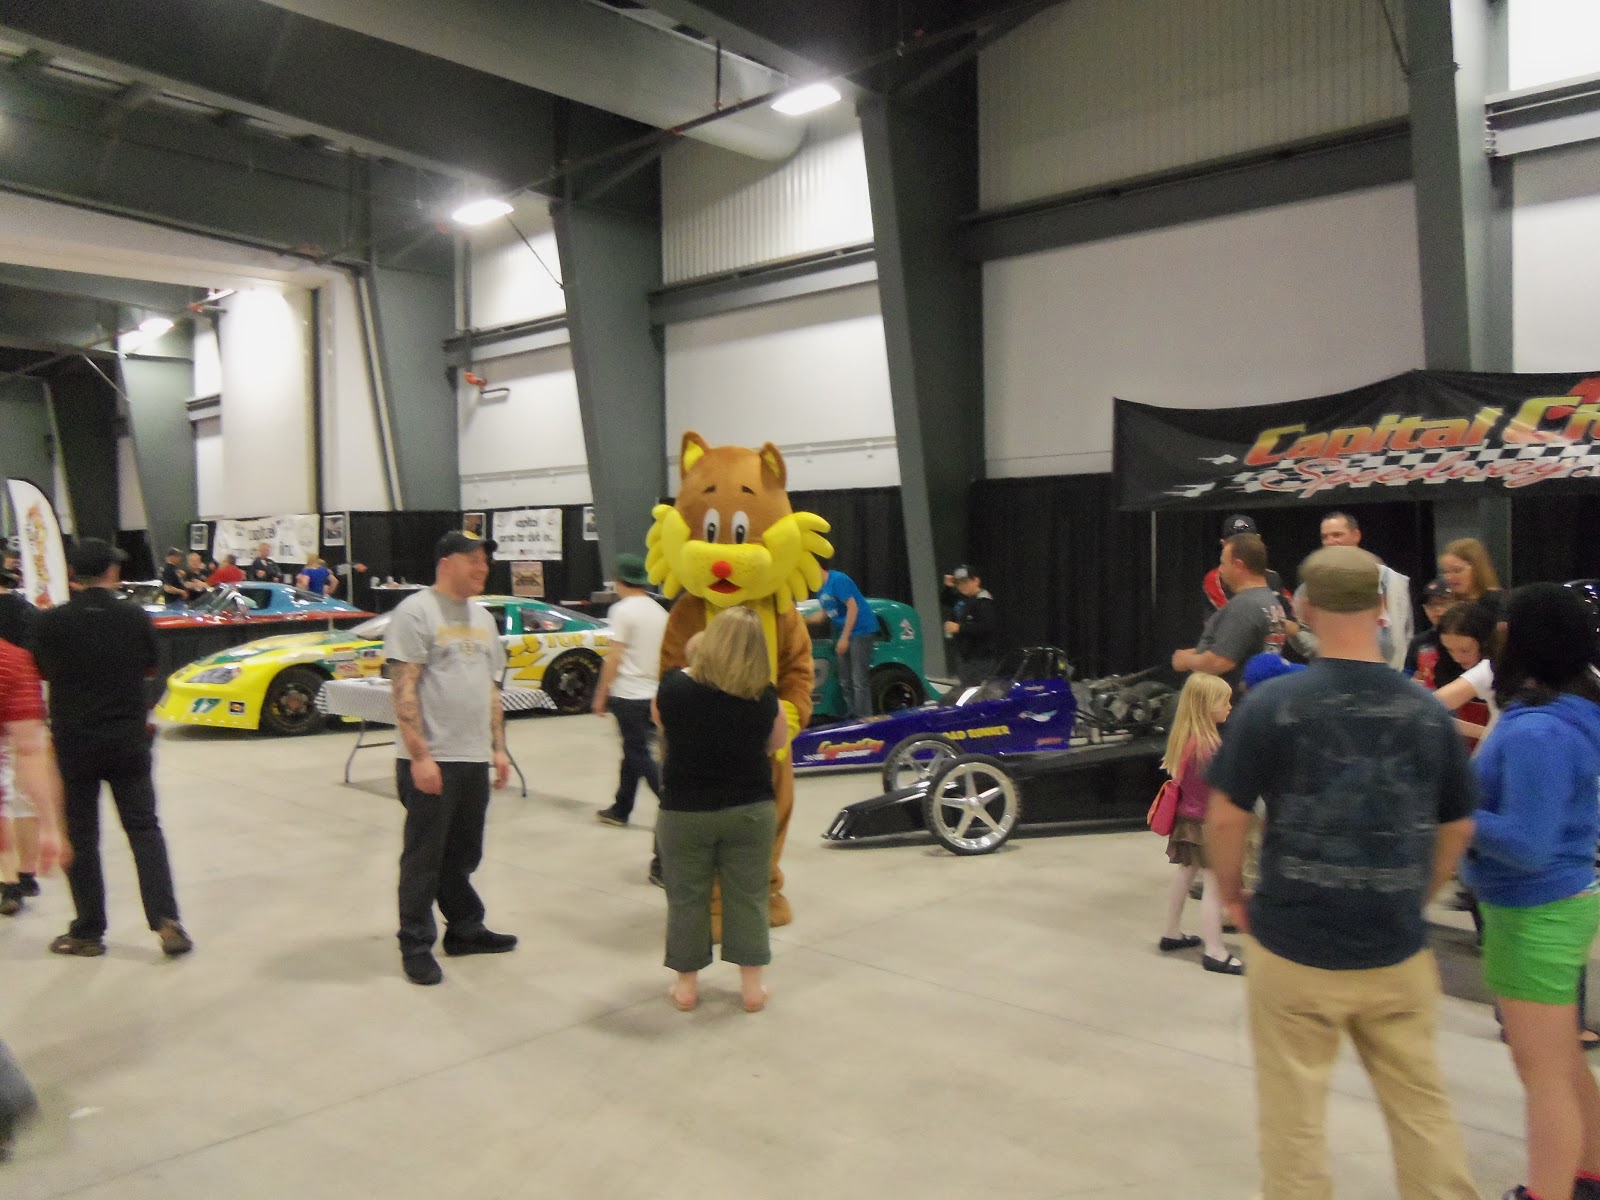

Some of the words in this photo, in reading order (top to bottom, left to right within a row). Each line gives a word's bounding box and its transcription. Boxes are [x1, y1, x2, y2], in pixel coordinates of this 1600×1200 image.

[1245, 407, 1504, 465] Capital
[1502, 396, 1600, 444] Ci
[191, 697, 222, 714] 17
